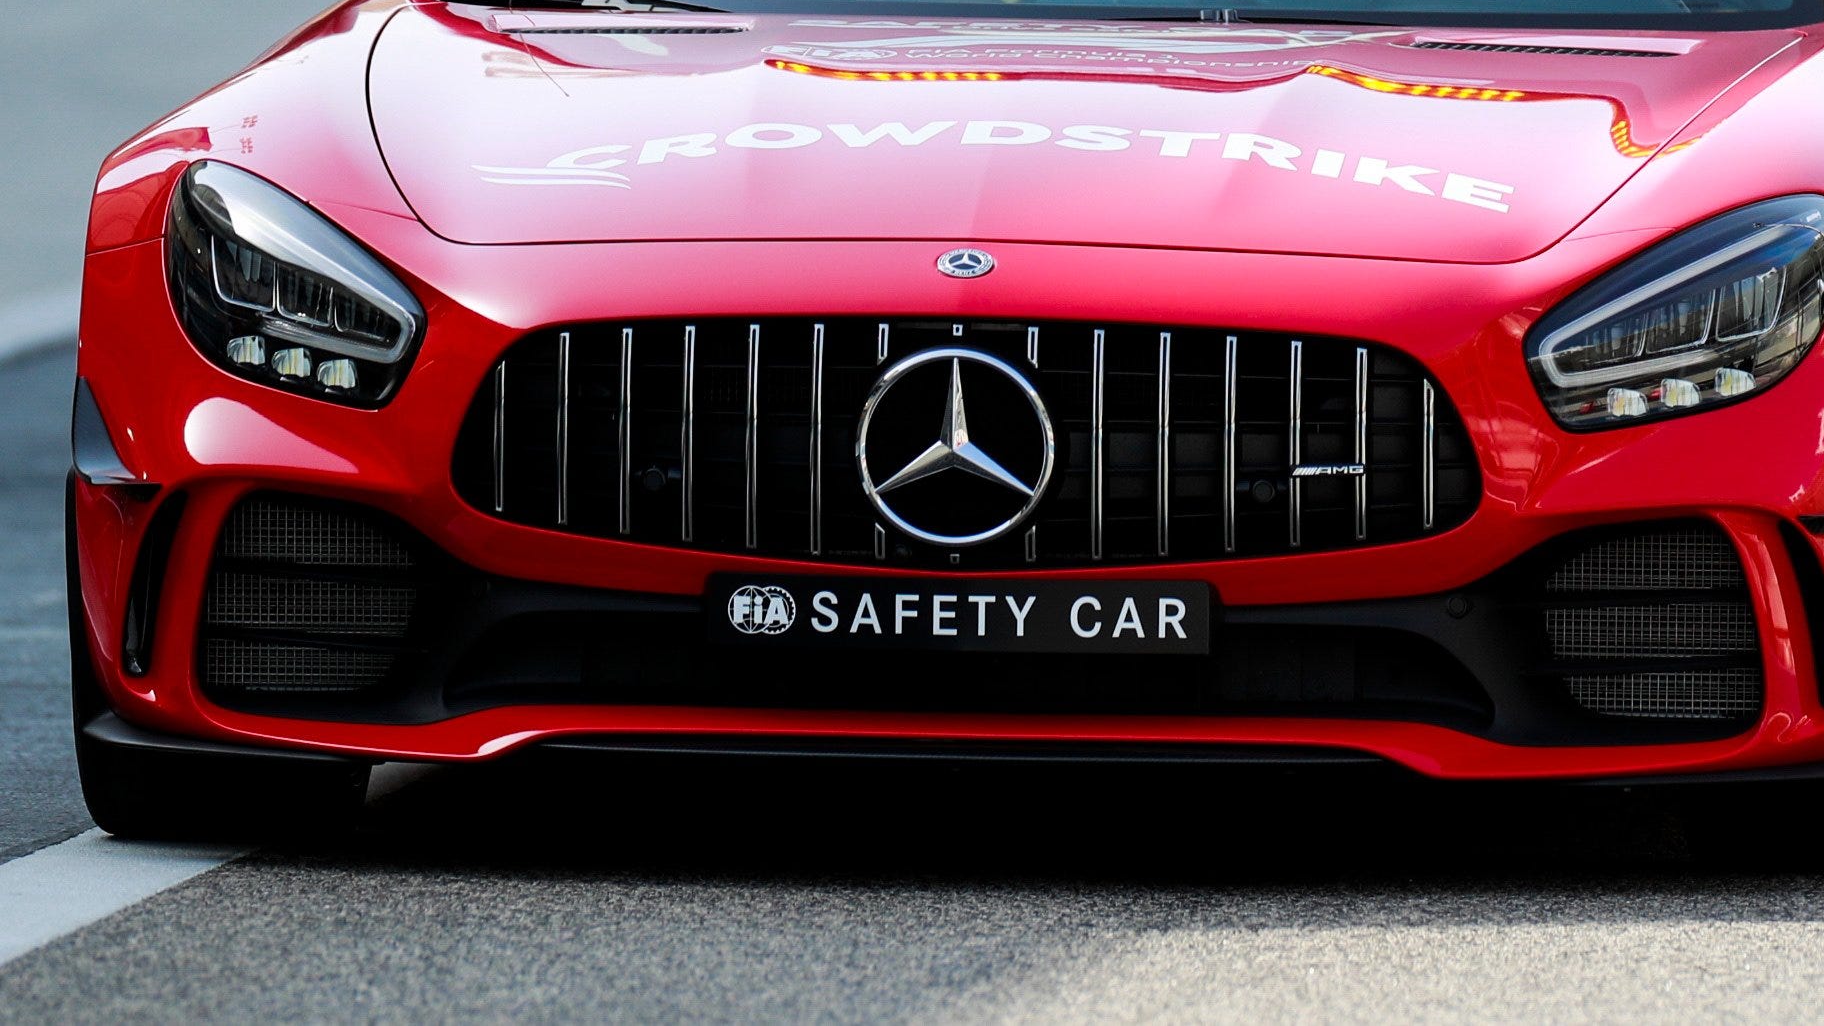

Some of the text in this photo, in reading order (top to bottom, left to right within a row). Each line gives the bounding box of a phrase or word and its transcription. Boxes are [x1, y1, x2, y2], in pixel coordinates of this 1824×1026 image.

[546, 120, 1516, 214] CROWDSTRIKE
[811, 590, 1036, 637] SAFETY
[1069, 595, 1188, 639] CAR
